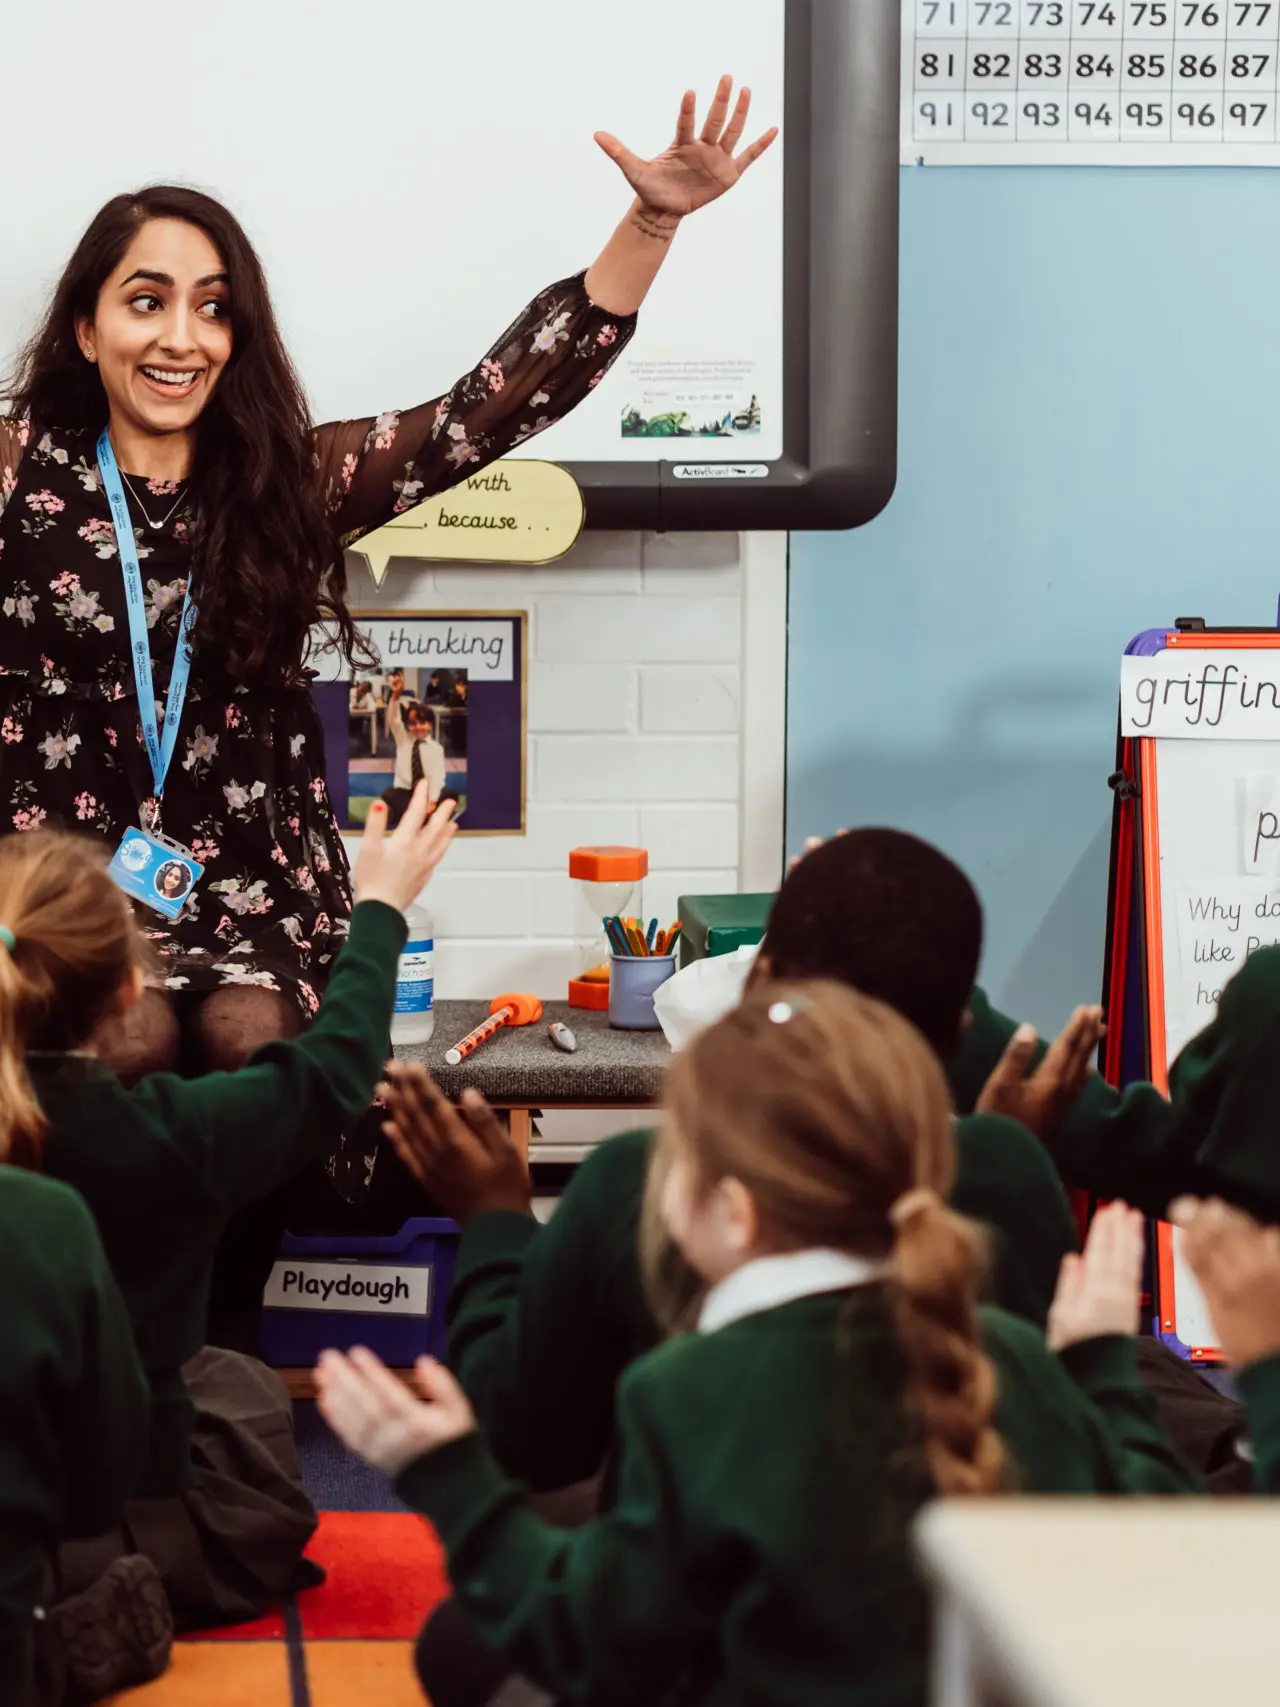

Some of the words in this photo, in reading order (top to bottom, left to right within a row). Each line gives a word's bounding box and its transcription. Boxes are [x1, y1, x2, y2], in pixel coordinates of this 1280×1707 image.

[923, 2, 954, 25] 71
[975, 3, 1011, 25] 72
[1027, 2, 1063, 26] 73
[1079, 3, 1116, 26] 74
[1130, 3, 1166, 27] 75
[1182, 3, 1219, 27] 76
[1234, 3, 1271, 26] 77
[920, 53, 954, 77] 81
[973, 54, 1010, 77] 82
[1024, 54, 1061, 78] 83
[1076, 54, 1114, 78] 84
[1128, 54, 1164, 78] 85
[1179, 55, 1217, 78] 86
[1231, 55, 1269, 77] 87
[920, 103, 952, 125] 91
[972, 103, 1008, 126] 92
[1023, 103, 1059, 126] 93
[1075, 103, 1112, 126] 94
[1126, 103, 1163, 126] 95
[1178, 104, 1215, 126] 96
[1230, 103, 1267, 126] 97
[467, 473, 511, 492] with
[438, 508, 518, 529] because
[388, 627, 504, 669] thinking
[1189, 896, 1241, 932] Why
[1194, 938, 1236, 963] like
[282, 1270, 410, 1304] Playdough
